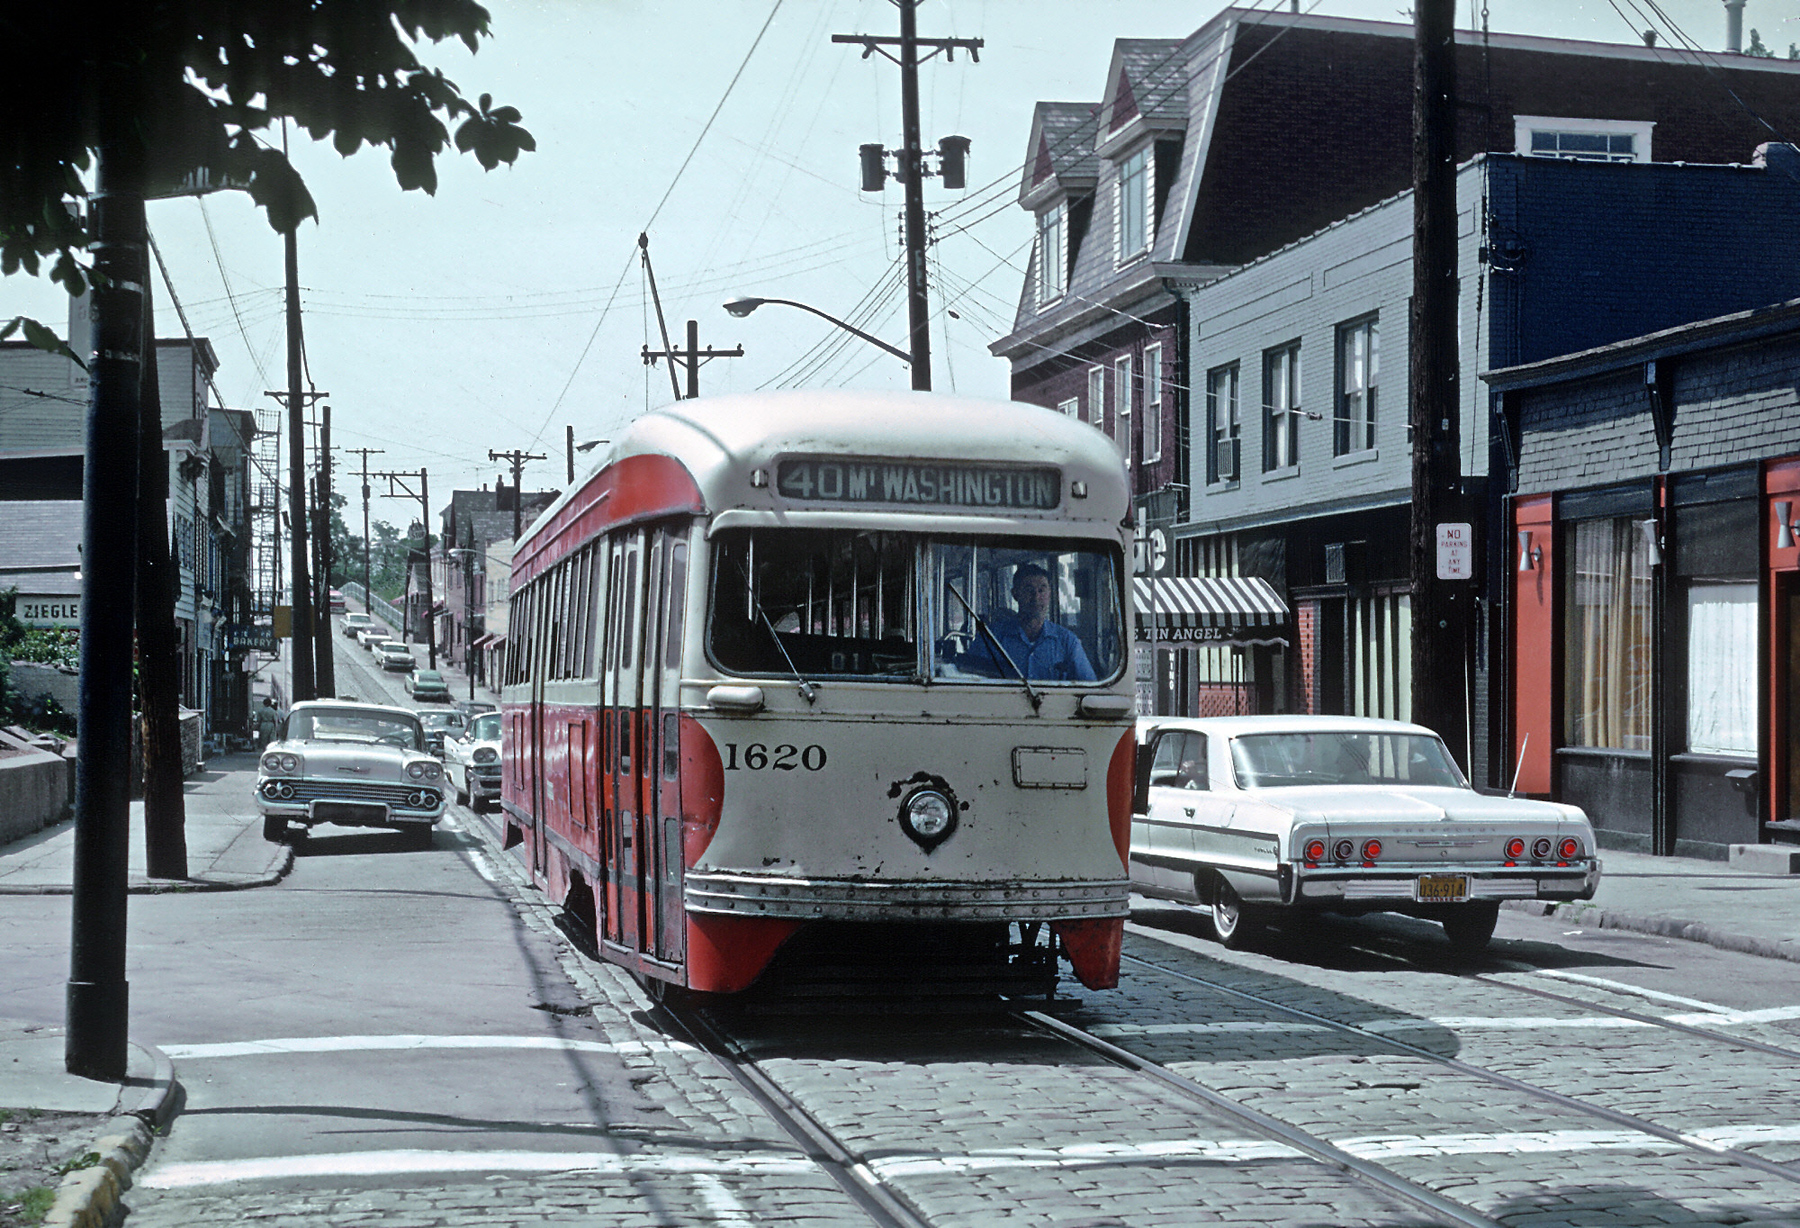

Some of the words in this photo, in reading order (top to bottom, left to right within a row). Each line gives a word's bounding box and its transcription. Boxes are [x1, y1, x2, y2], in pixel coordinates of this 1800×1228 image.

[783, 464, 843, 499] 40
[882, 464, 1053, 507] WASHINGTON
[1447, 529, 1461, 539] NO
[1172, 627, 1222, 640] ANGEL
[233, 636, 273, 648] BAKERY
[724, 742, 828, 772] 1620
